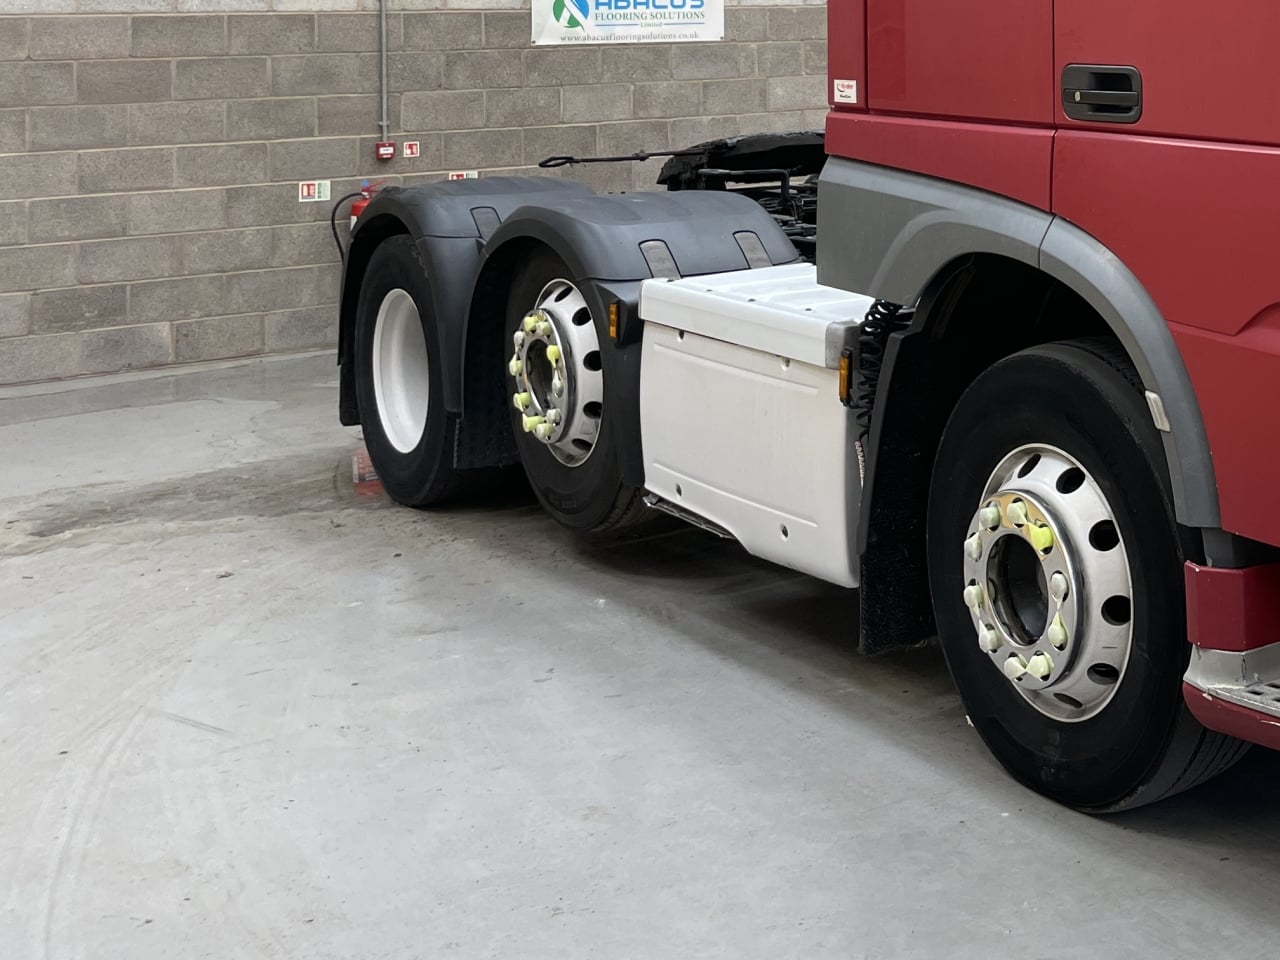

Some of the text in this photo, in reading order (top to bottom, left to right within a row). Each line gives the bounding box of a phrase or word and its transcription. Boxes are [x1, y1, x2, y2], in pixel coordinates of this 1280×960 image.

[594, 10, 706, 21] FLOORING SOLUTIONS
[559, 31, 699, 43] www.abacusflooringsolutions.co.uk
